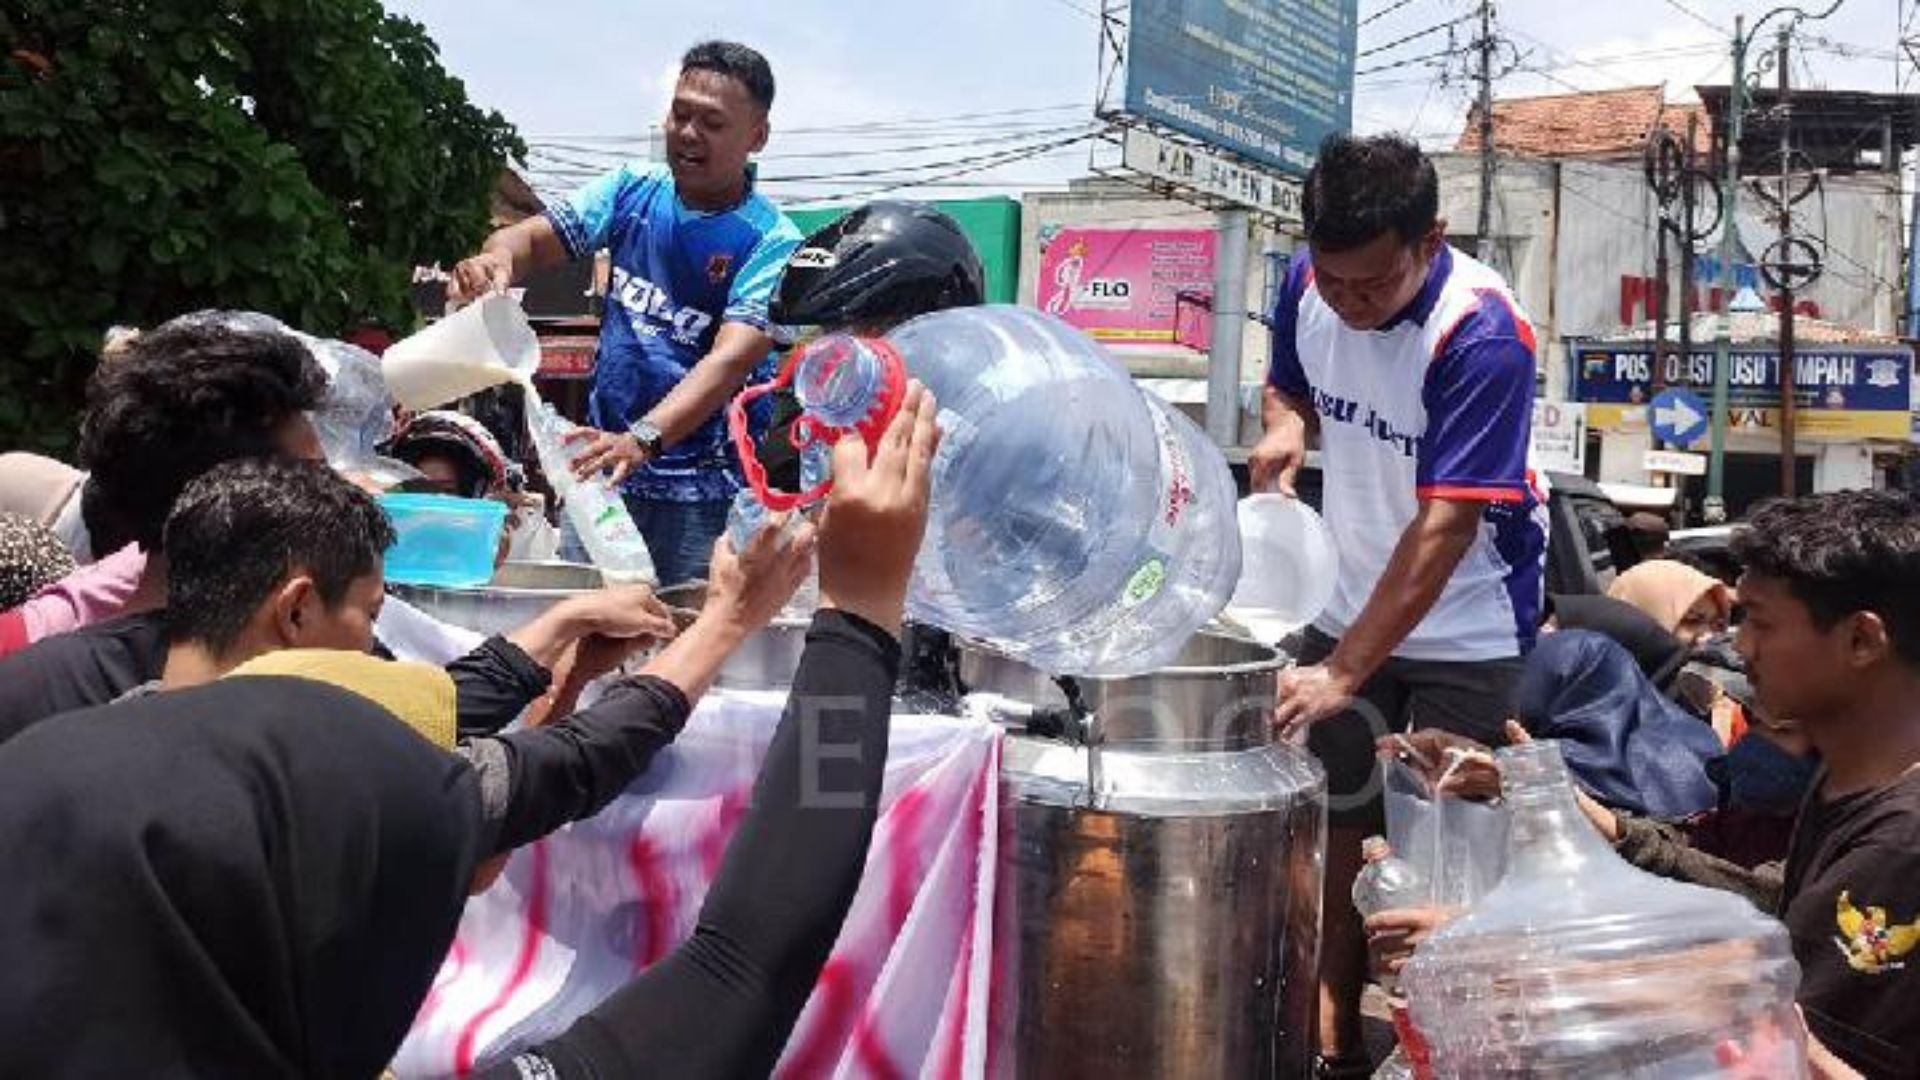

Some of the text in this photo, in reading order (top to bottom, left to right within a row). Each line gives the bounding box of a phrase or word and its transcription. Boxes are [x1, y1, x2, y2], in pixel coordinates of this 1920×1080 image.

[1615, 353, 1650, 381] POS
[1720, 355, 1767, 385] USU
[1771, 356, 1855, 385] TMPAH
